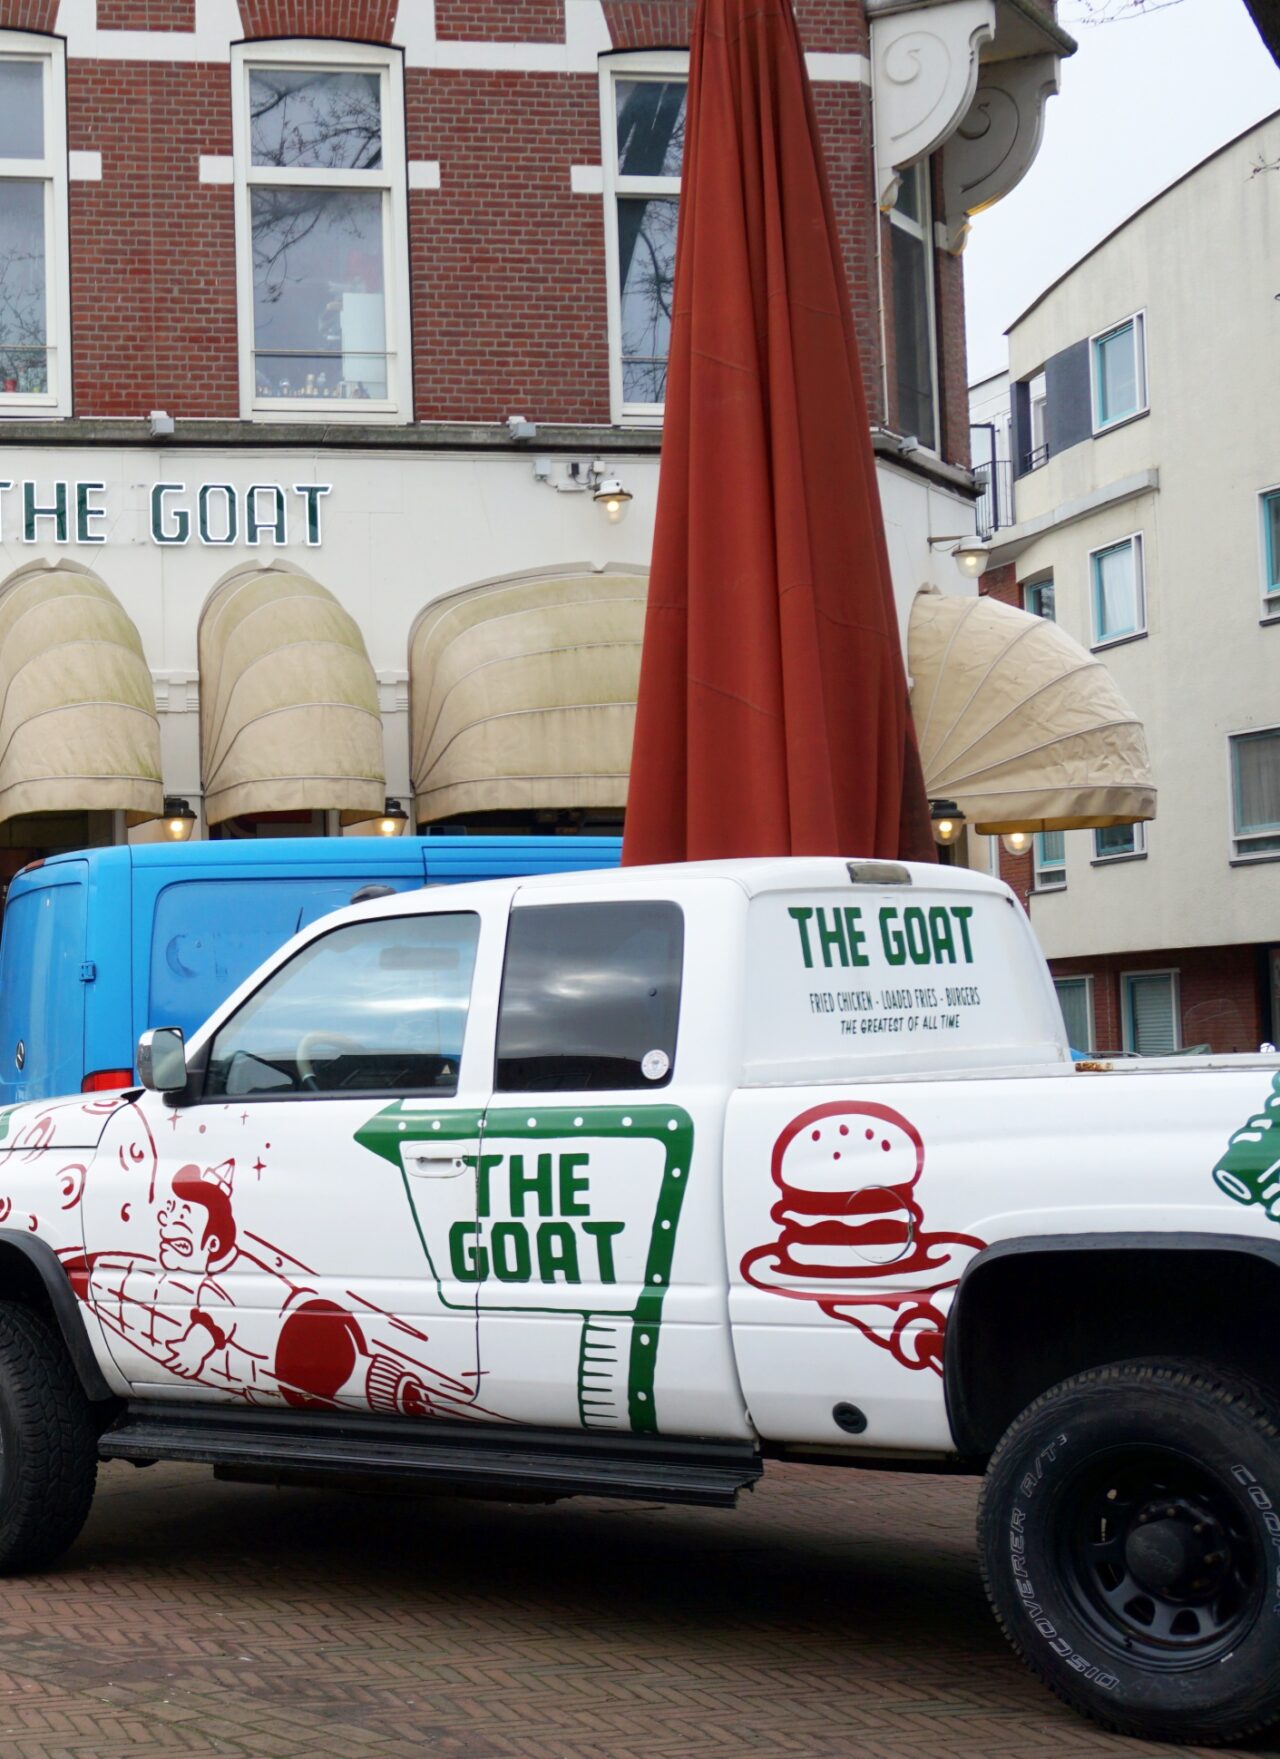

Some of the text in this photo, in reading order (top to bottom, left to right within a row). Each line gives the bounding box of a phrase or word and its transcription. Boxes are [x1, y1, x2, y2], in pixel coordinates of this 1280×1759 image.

[150, 482, 333, 546] GOAT
[788, 906, 975, 968] THE GOAT
[809, 992, 835, 1014] FRIED
[836, 990, 874, 1012] CHICKEN
[881, 989, 913, 1010] LOADED
[914, 988, 938, 1009] FRIES
[945, 986, 981, 1006] BURGERS
[841, 1014, 960, 1035] THE GREATEST OF ALL TIME
[463, 1153, 590, 1217] THE
[449, 1221, 626, 1284] GOAT
[1011, 1508, 1120, 1690] DISCOVERER
